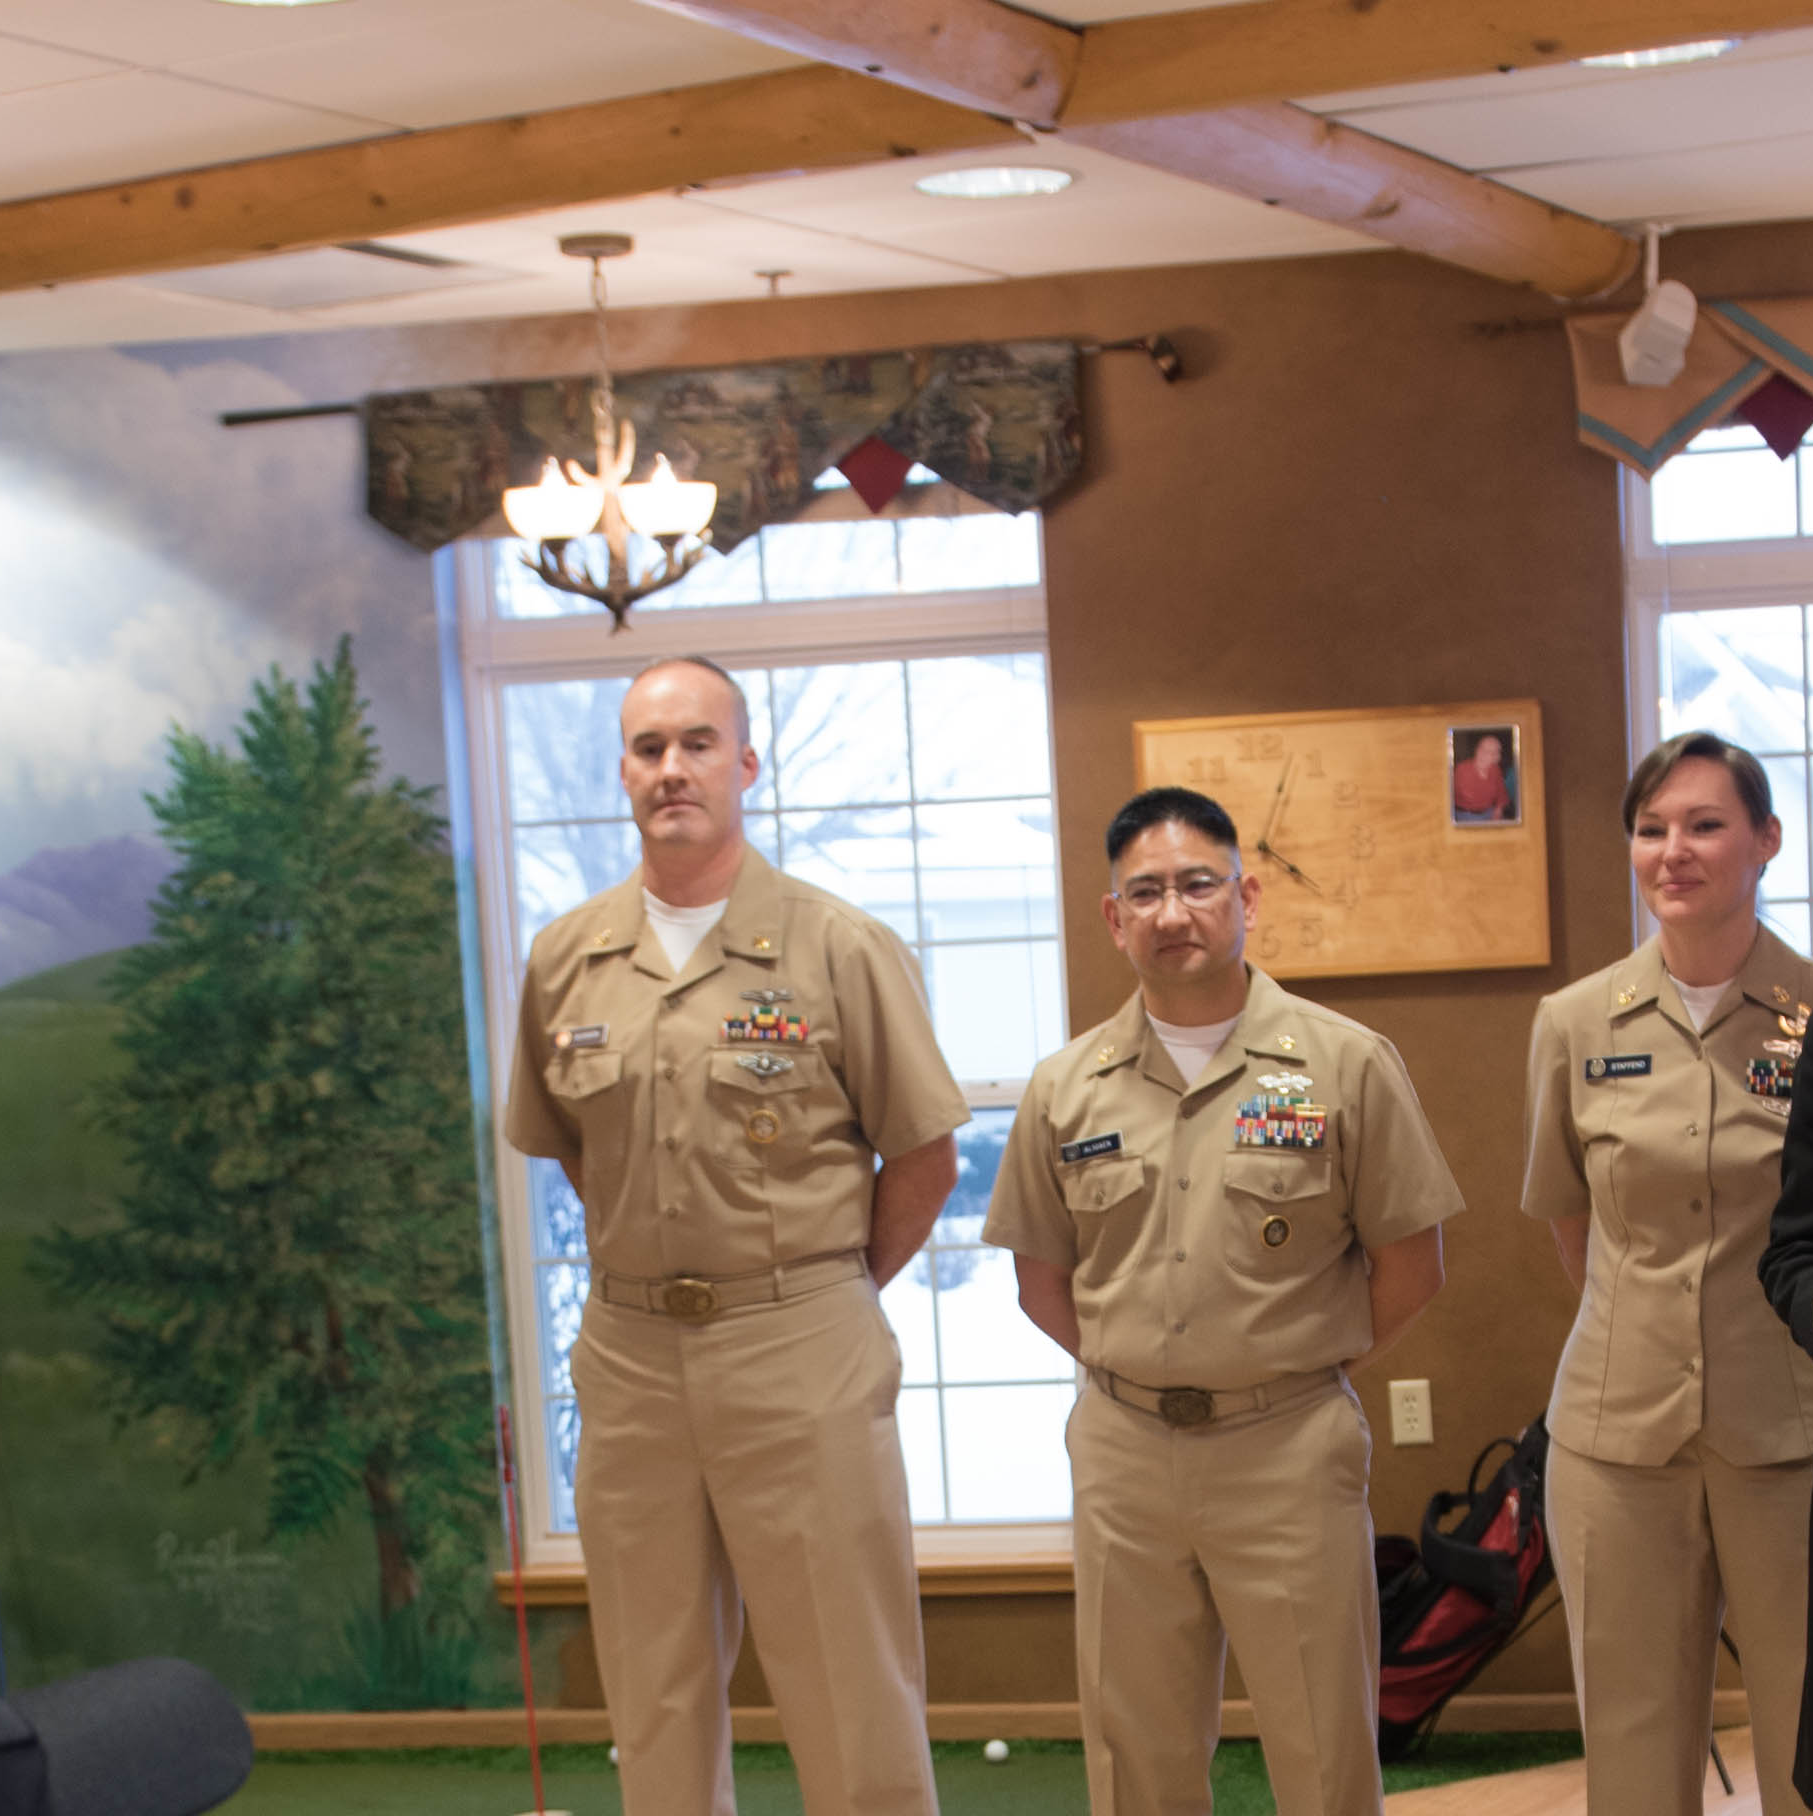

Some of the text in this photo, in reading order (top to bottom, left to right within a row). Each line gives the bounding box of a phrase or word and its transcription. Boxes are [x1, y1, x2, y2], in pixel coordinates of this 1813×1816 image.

[1236, 733, 1283, 762] 12
[1188, 756, 1229, 783] 11
[1333, 780, 1361, 809] 2
[1349, 824, 1376, 861] 3
[1329, 874, 1360, 911] 4
[1256, 924, 1282, 959] 6
[1298, 916, 1324, 948] 5
